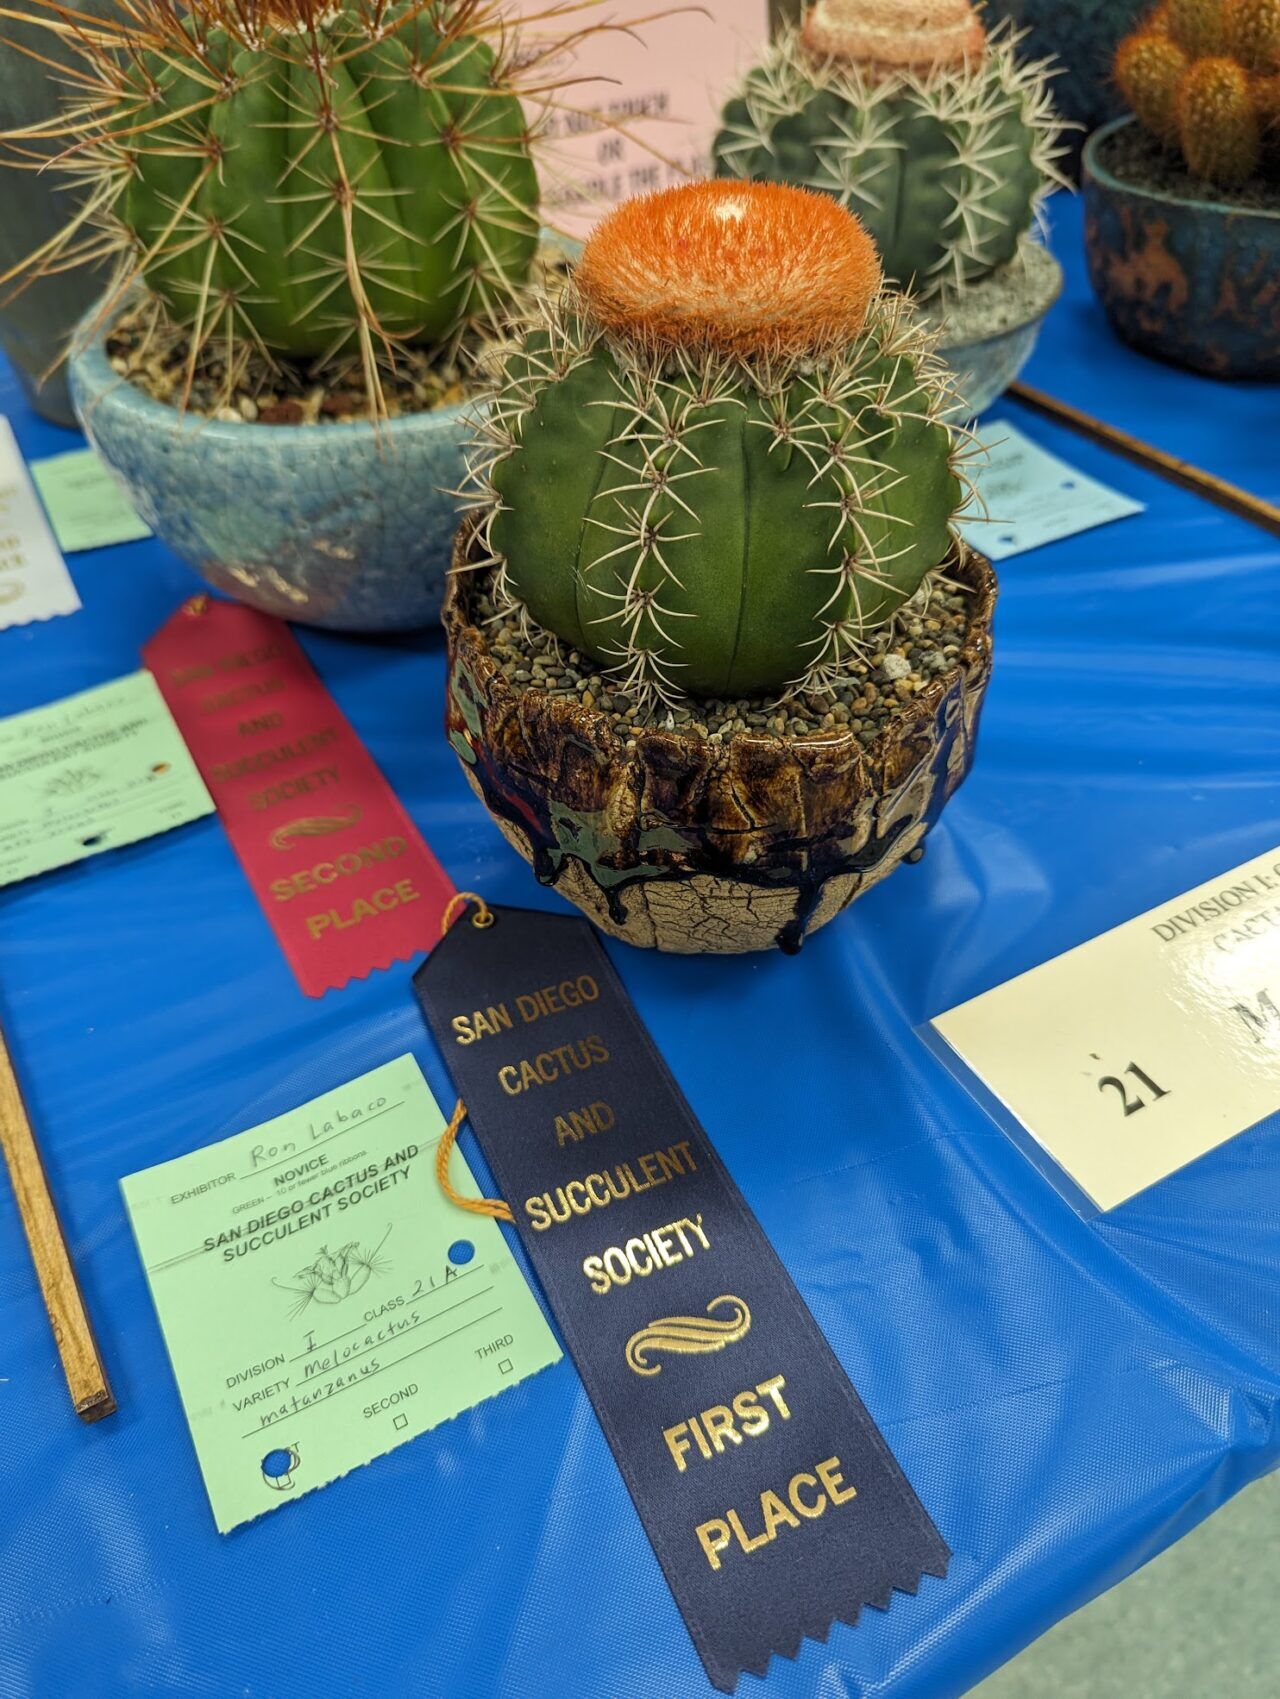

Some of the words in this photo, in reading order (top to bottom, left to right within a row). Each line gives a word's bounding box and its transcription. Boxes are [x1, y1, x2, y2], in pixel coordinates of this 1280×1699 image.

[269, 836, 408, 902] SECOND
[305, 878, 420, 940] PLACE
[1150, 880, 1260, 943] DIVISION
[451, 1003, 513, 1046] SAN
[515, 974, 600, 1024] DIEGO
[497, 1034, 611, 1096] CACTUS
[1097, 1061, 1172, 1117] 21
[250, 1142, 297, 1169] Ron
[310, 1096, 387, 1140] Labaco
[553, 1101, 616, 1147] AND
[170, 1171, 237, 1204] EXHIBITOR
[203, 1227, 243, 1254] SAN
[246, 1197, 306, 1236] DIEGO
[308, 1162, 381, 1208] CACTUS
[383, 1142, 421, 1172] AND
[273, 1153, 330, 1187] NOVICE
[524, 1140, 699, 1233] SUCCULENT
[222, 1205, 334, 1264] SUCCULENT
[337, 1165, 412, 1211] SOCIETY
[581, 1211, 712, 1296] SOCIETY
[363, 1295, 405, 1323] CLASS
[225, 1352, 287, 1391] DIVISION
[474, 1334, 515, 1360] THIRD
[231, 1376, 293, 1413] VARIETY
[259, 1358, 382, 1428] matanzanus
[361, 1381, 421, 1419] SECOND
[661, 1373, 792, 1474] FIRST
[694, 1455, 858, 1572] PLACE
